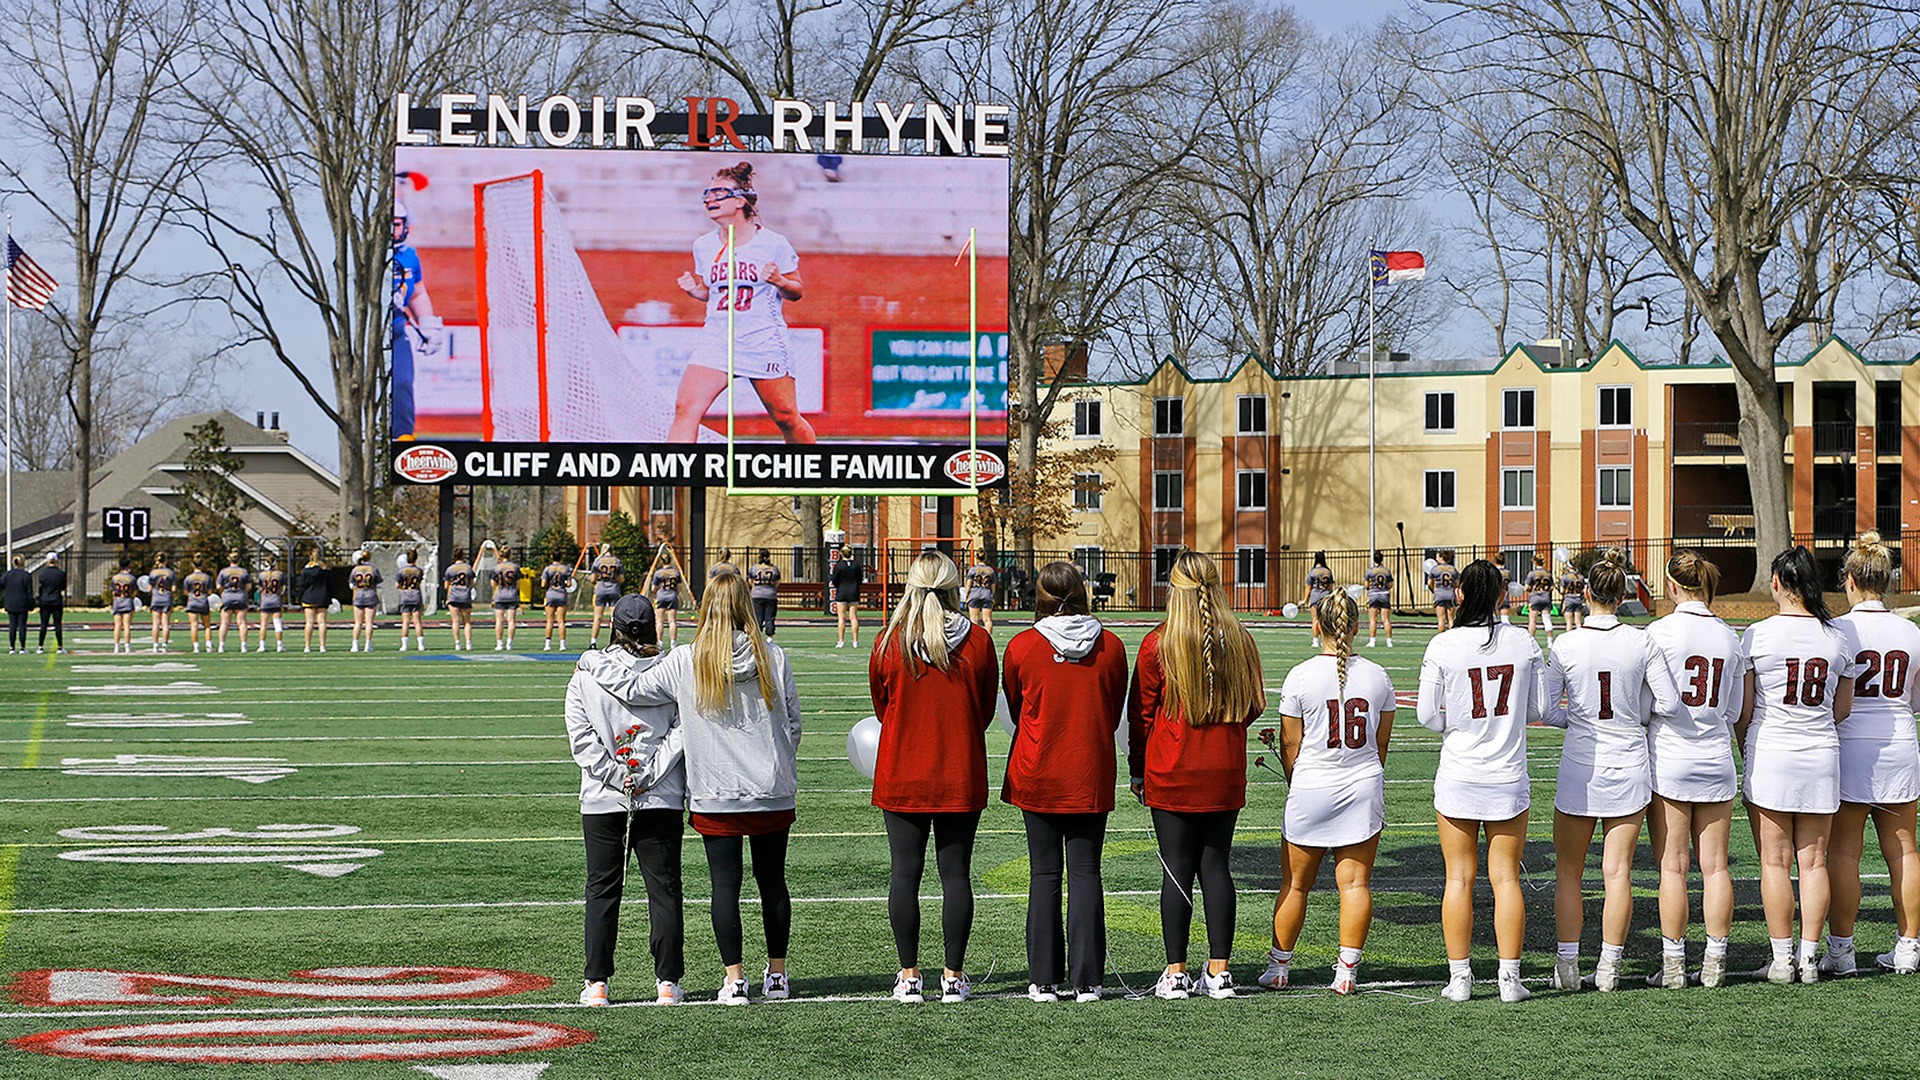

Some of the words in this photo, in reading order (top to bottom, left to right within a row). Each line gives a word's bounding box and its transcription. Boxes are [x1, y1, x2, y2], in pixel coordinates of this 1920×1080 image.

[396, 92, 657, 147] LENOIR
[773, 99, 1010, 155] RHYNE
[717, 285, 754, 312] 20
[394, 453, 457, 475] Cheerwine
[464, 452, 550, 477] CLIFF
[556, 452, 621, 478] AND
[628, 453, 697, 478] AMY
[704, 453, 822, 479] RTCHIE
[830, 454, 937, 480] FAMILY
[106, 511, 147, 540] 90
[354, 573, 373, 589] 23
[498, 570, 514, 586] 15
[755, 570, 772, 586] 17
[1440, 573, 1450, 588] 6
[1468, 664, 1514, 719] 17
[1682, 655, 1724, 707] 31
[1783, 658, 1828, 706] 18
[1855, 650, 1910, 697] 20
[1598, 671, 1613, 719] 1
[1326, 698, 1370, 749] 16
[57, 824, 385, 863] 30
[5, 966, 596, 1063] 20
